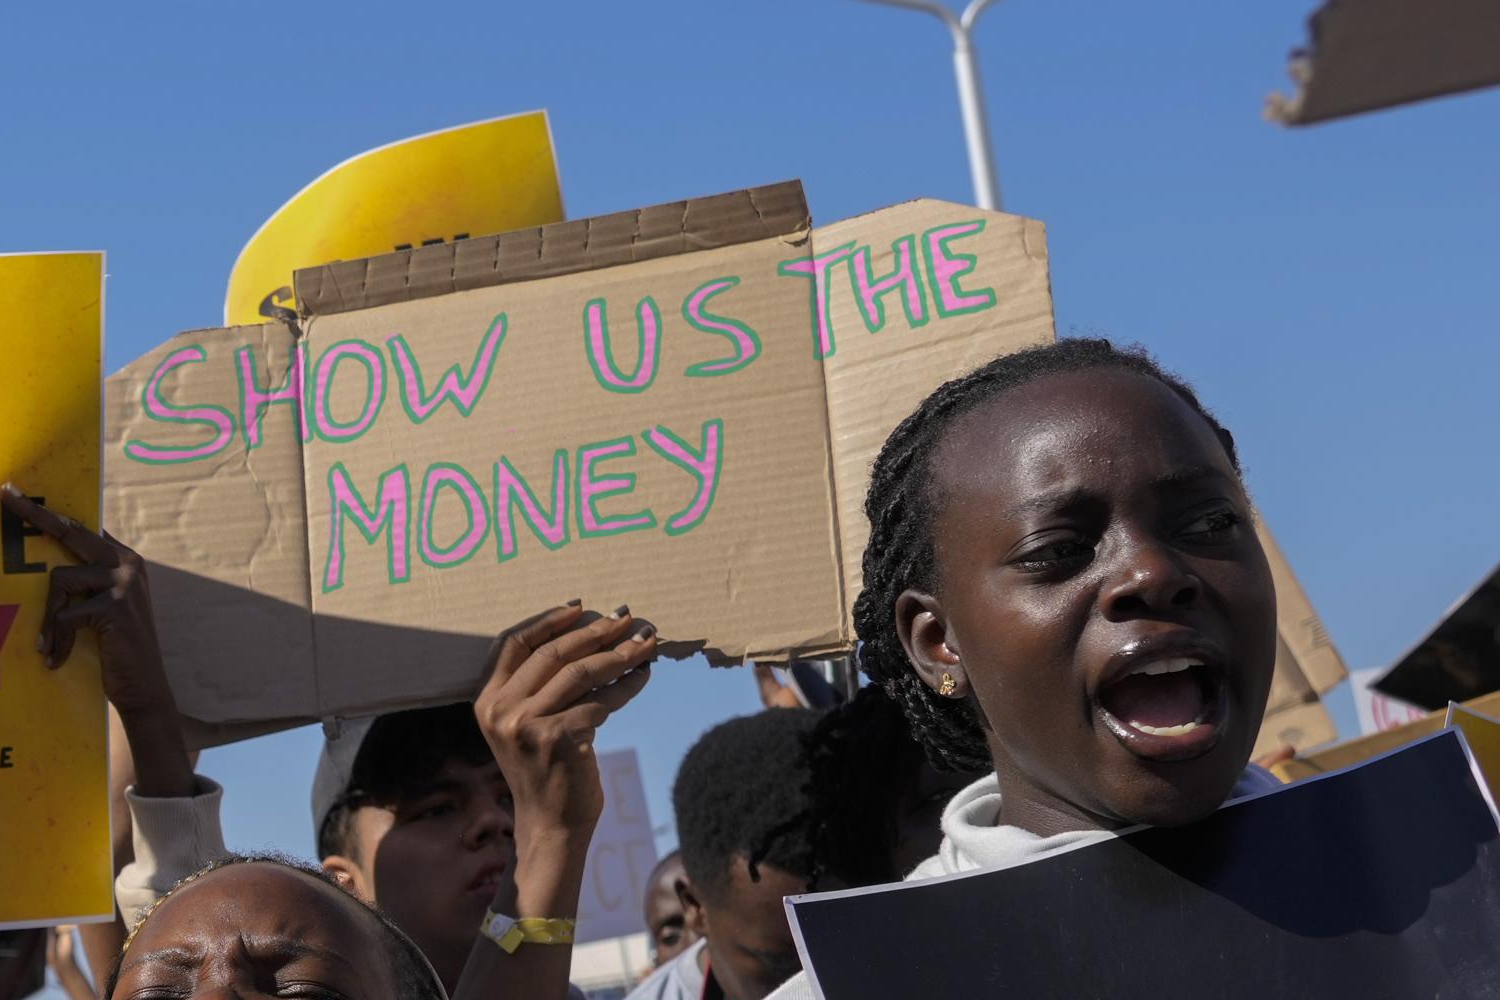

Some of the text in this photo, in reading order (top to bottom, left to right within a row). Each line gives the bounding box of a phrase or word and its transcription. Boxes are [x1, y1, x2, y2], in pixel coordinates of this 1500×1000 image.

[124, 219, 996, 466] SHOW US THE
[322, 418, 723, 593] MONEY
